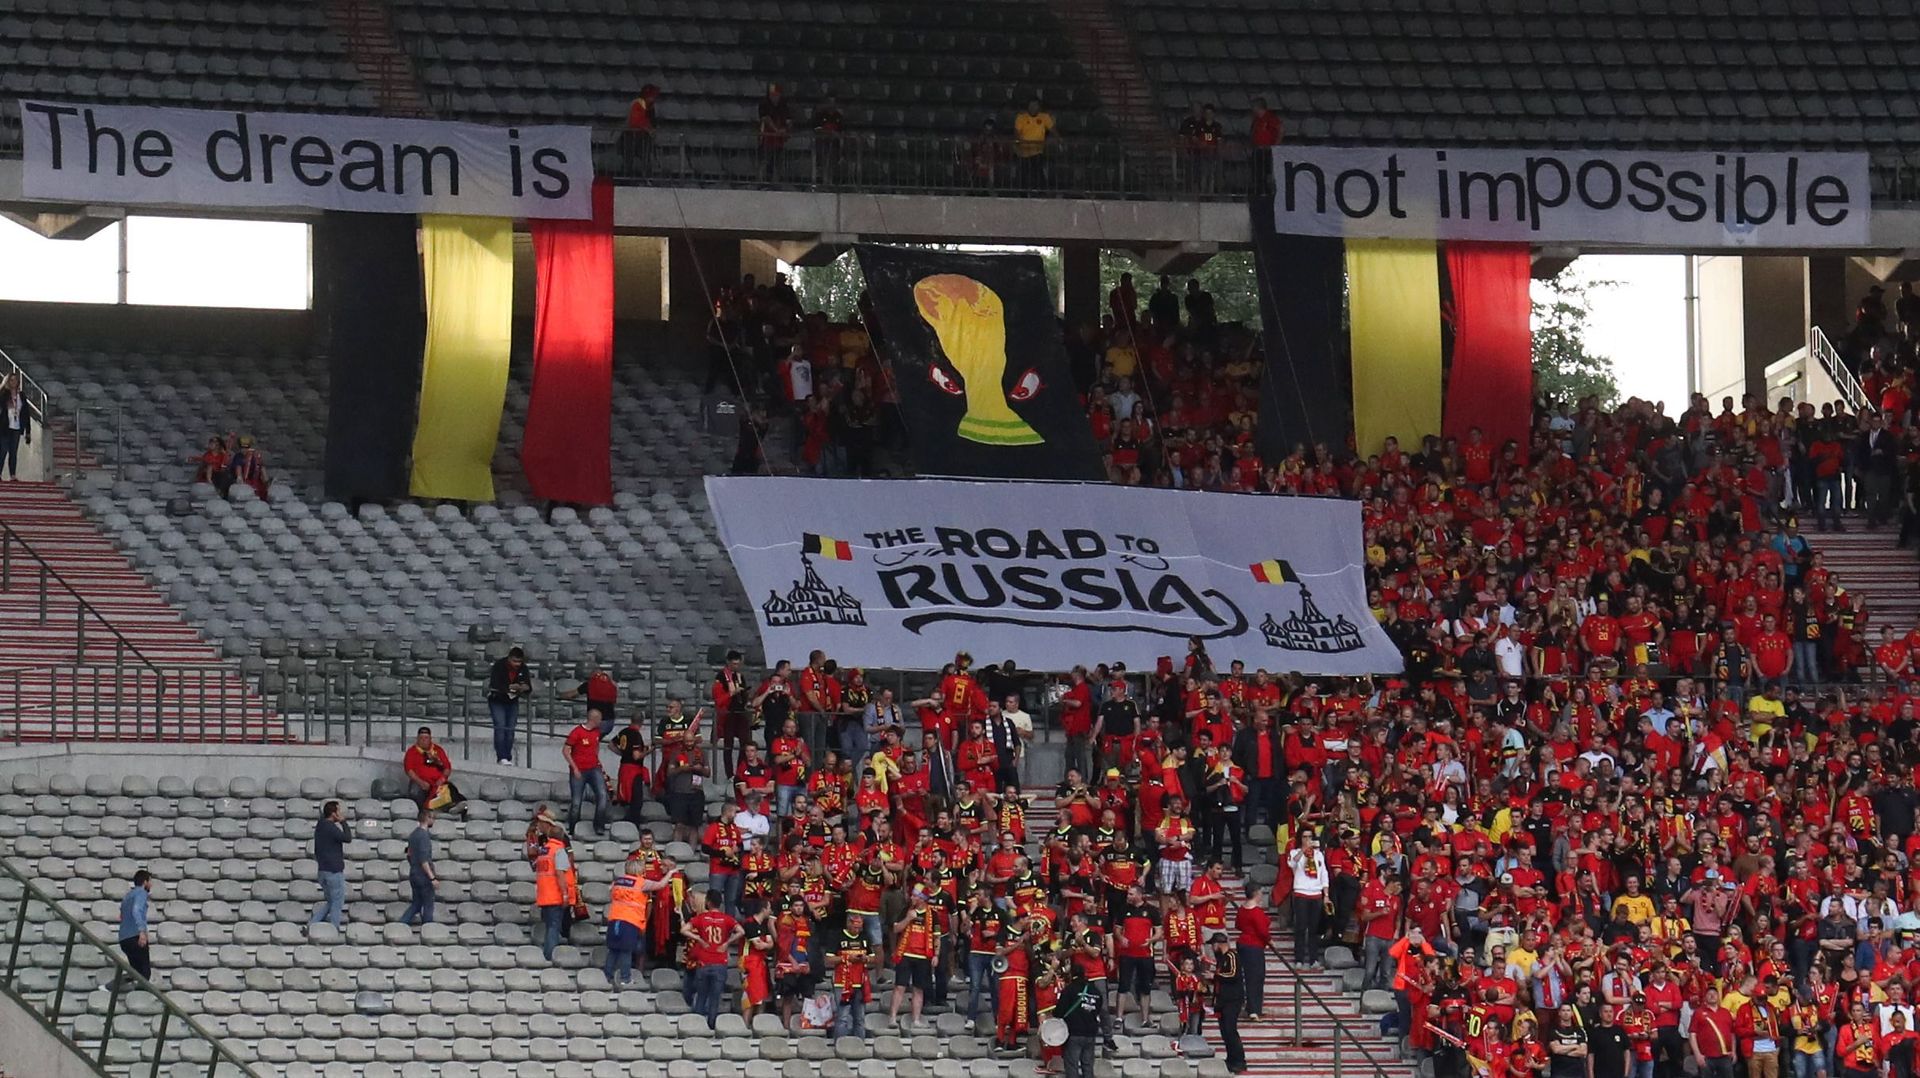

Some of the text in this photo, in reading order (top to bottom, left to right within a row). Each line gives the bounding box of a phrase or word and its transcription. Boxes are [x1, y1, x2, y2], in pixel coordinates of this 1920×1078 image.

[25, 103, 570, 199] The dream is
[1284, 150, 1850, 231] not impossible
[863, 526, 1160, 560] THE ROAD TO
[876, 563, 1228, 627] RUSSIA
[1469, 1013, 1481, 1037] 10
